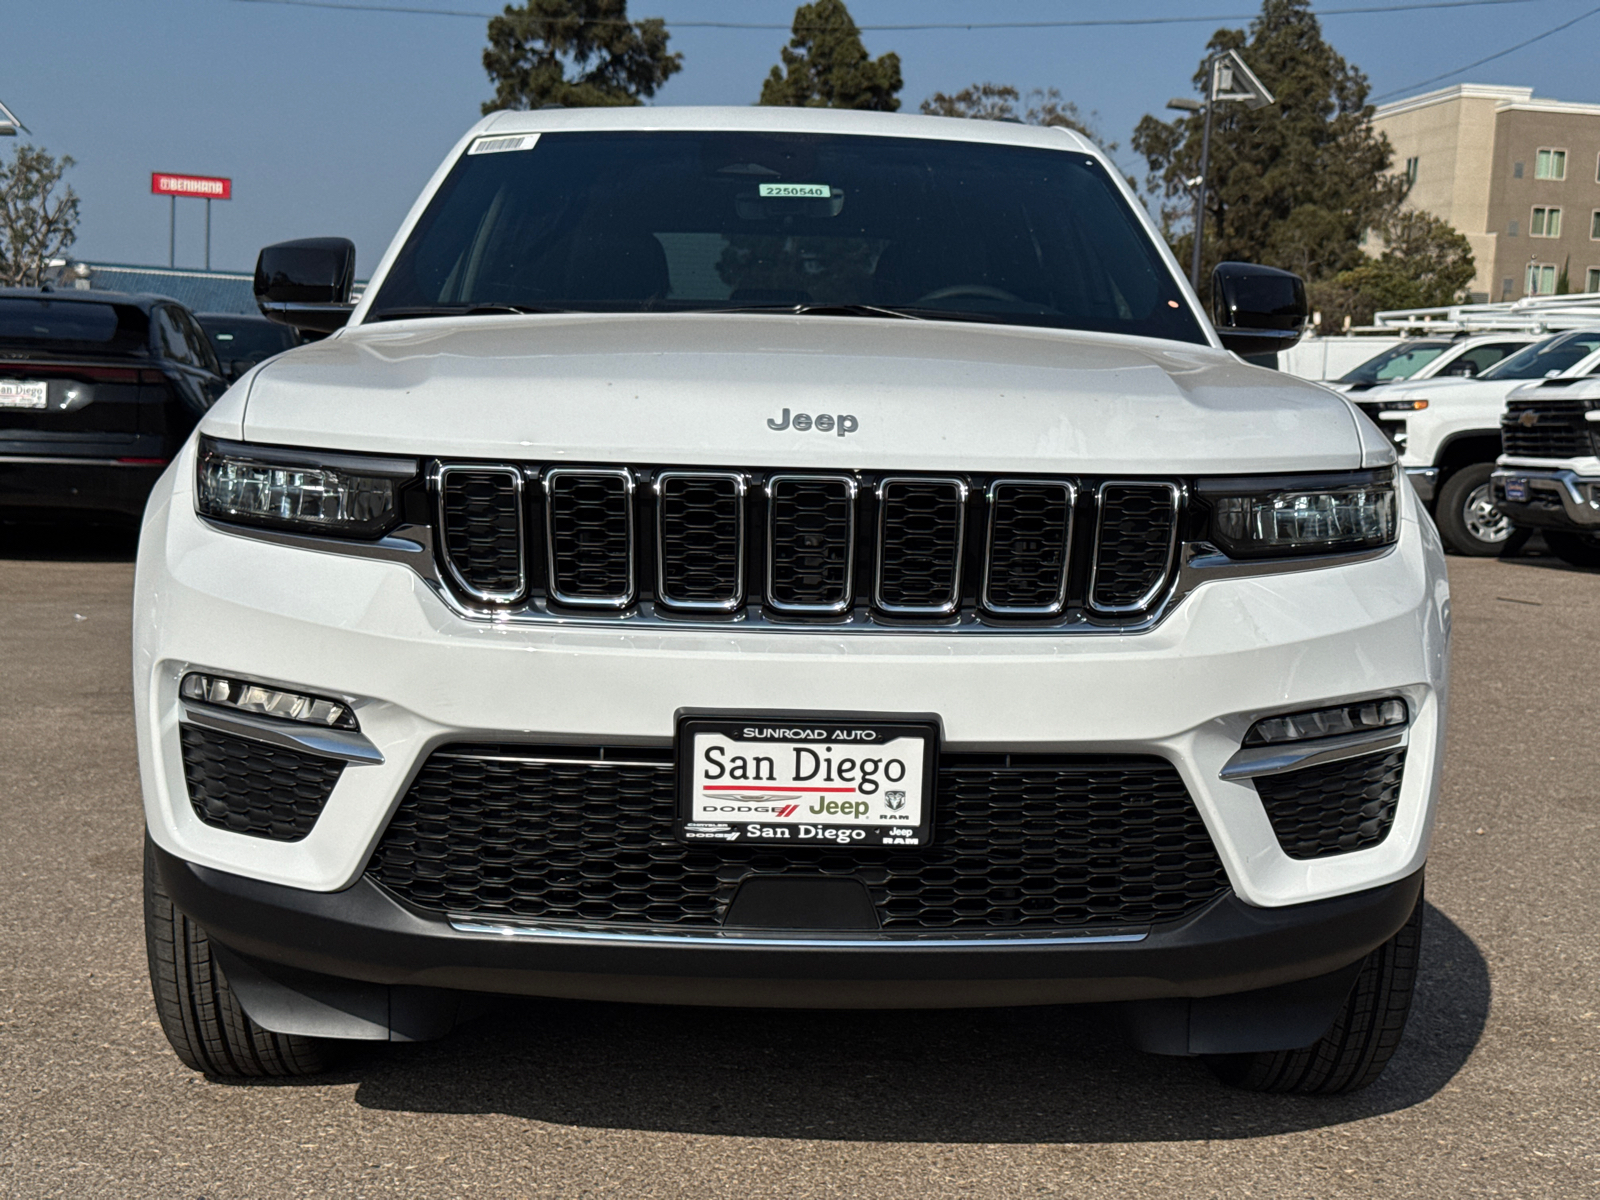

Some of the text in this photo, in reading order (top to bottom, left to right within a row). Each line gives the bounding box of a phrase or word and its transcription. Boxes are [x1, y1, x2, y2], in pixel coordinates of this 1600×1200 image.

[766, 187, 823, 196] 2250540
[16, 385, 43, 398] Diego
[767, 408, 859, 437] Jeep
[743, 728, 876, 741] SUNROAD AUTO
[704, 746, 906, 795] San Diego
[809, 796, 869, 819] Jeep
[746, 825, 866, 843] San Diego
[889, 827, 913, 837] Jeep
